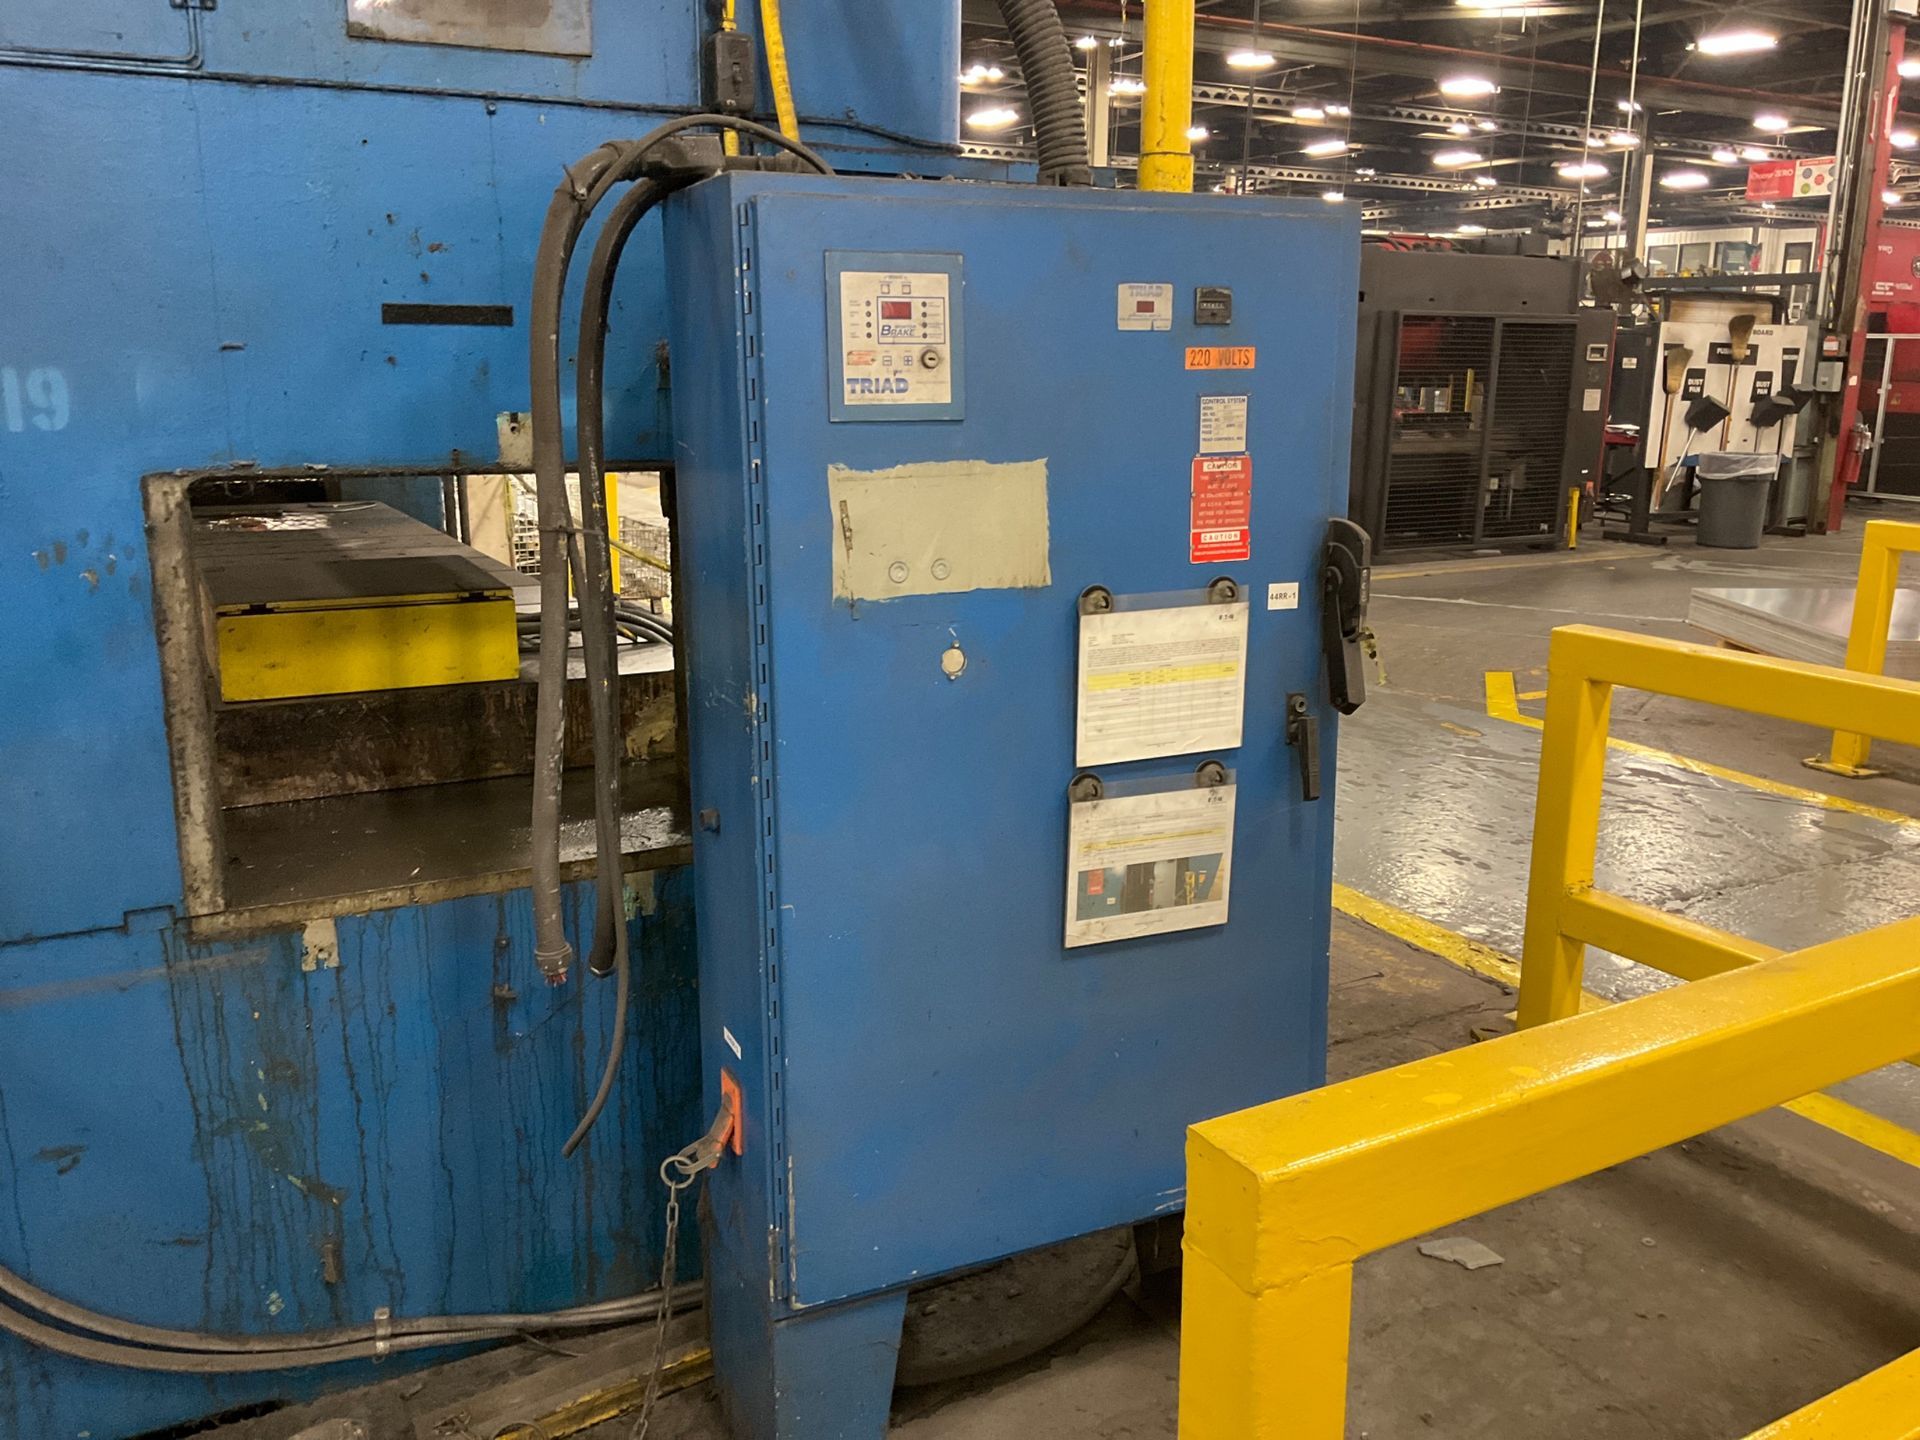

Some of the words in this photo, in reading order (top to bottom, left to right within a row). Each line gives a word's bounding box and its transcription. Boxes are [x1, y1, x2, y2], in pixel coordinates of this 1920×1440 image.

[881, 324, 915, 336] BRAKE
[1190, 349, 1211, 366] 220
[1217, 349, 1250, 366] VOLTS
[846, 377, 909, 394] TRIAD
[1206, 462, 1238, 470] CAUTION
[1203, 533, 1238, 541] CAUTION
[1269, 592, 1297, 601] 44RR-1
